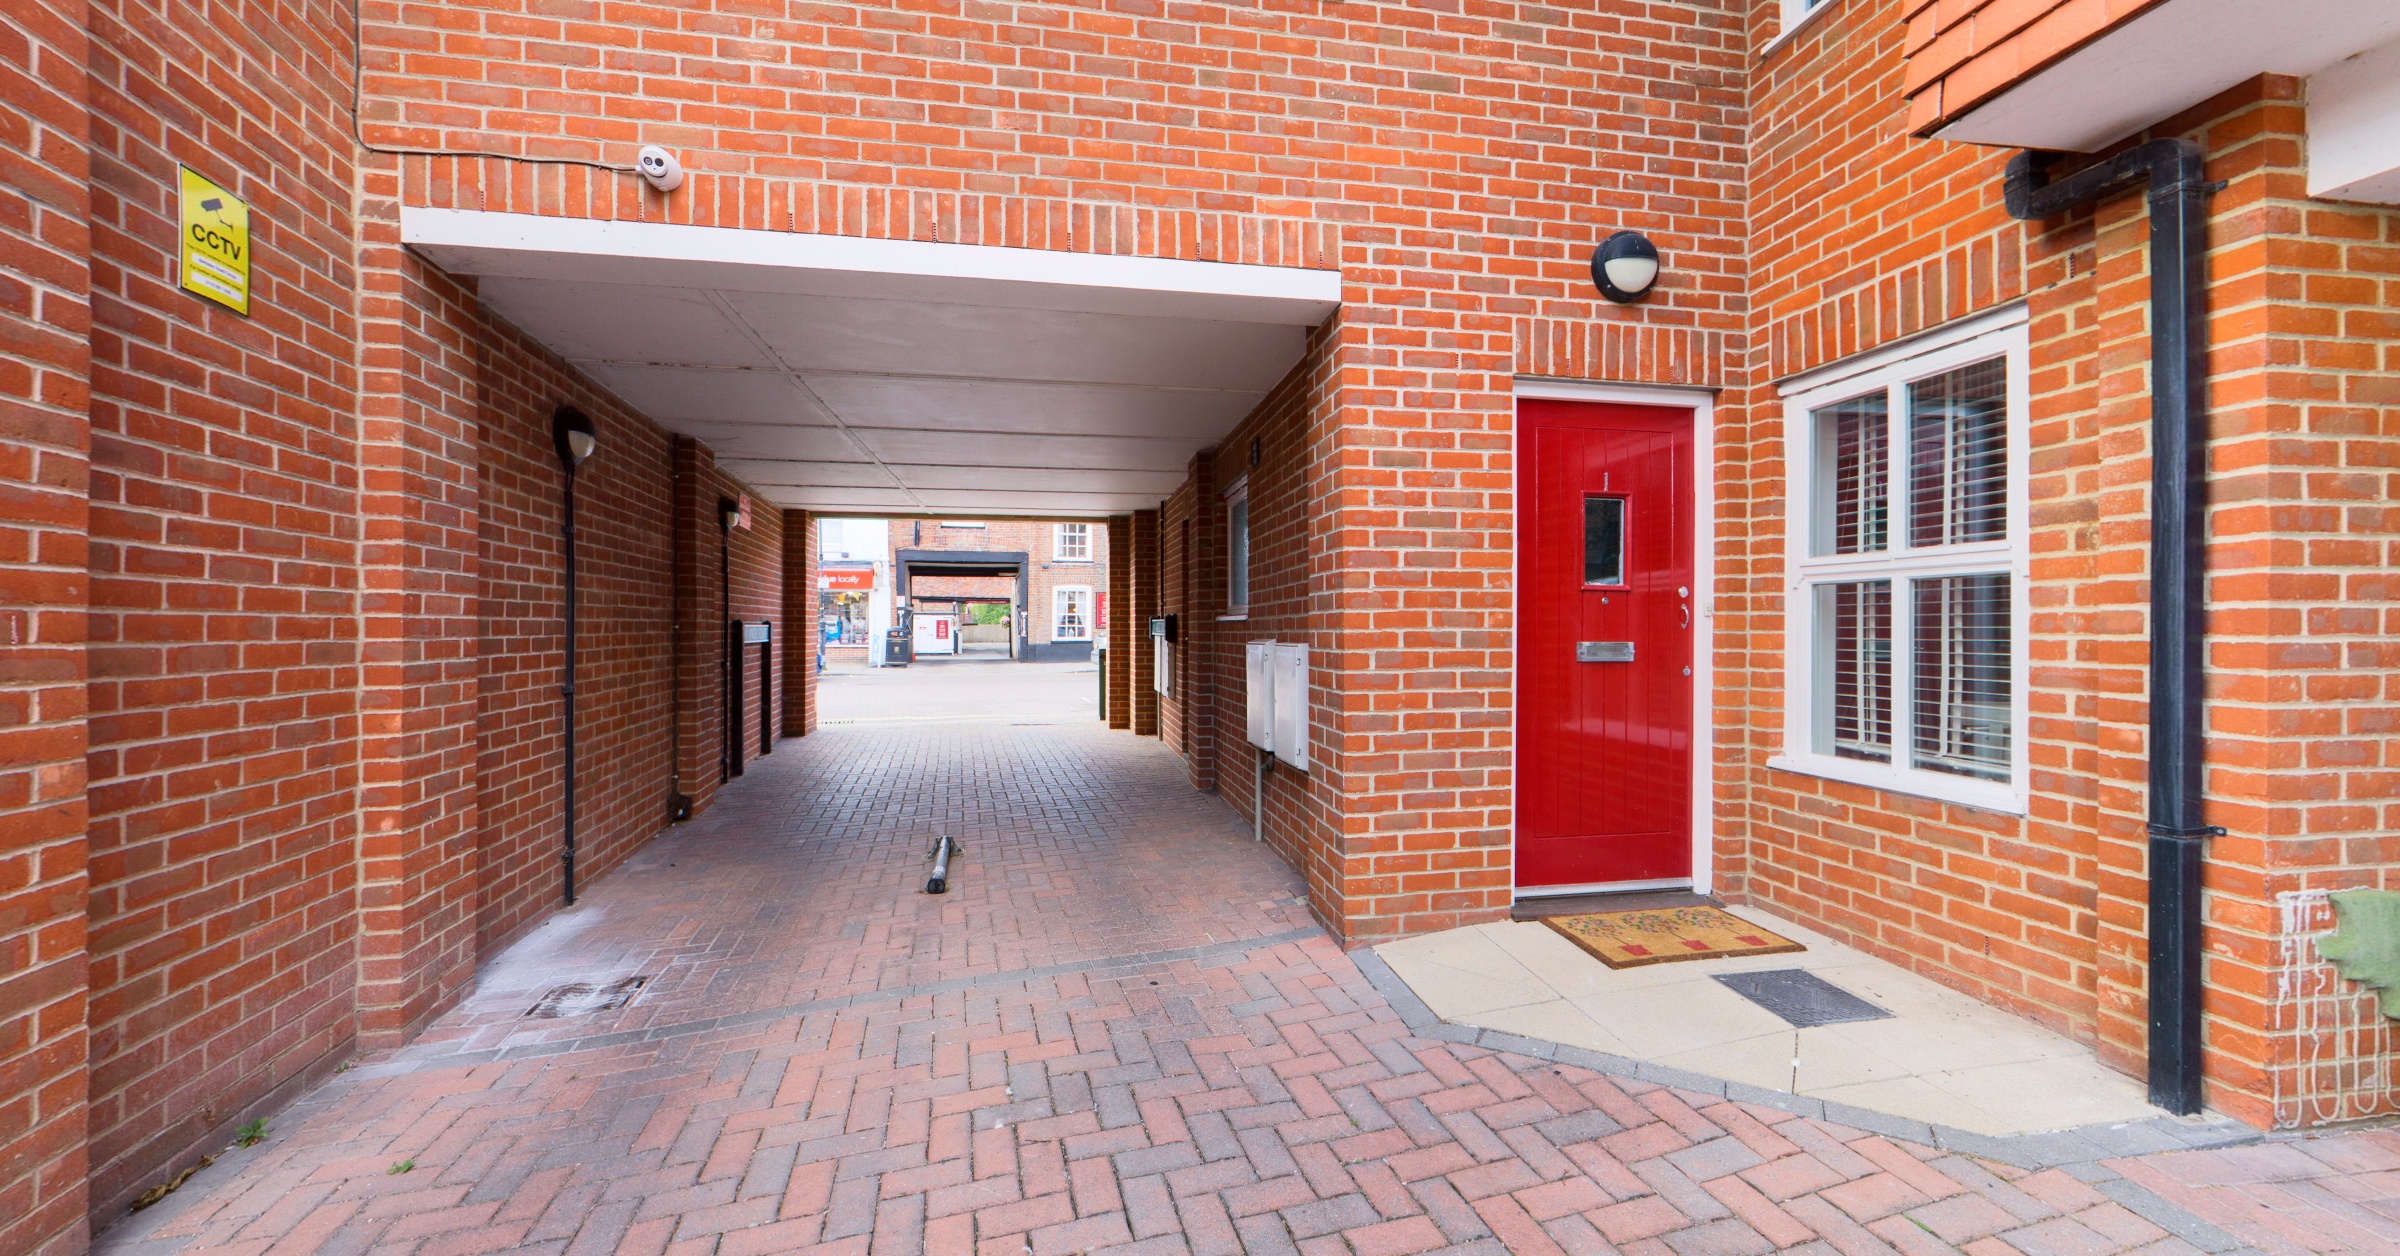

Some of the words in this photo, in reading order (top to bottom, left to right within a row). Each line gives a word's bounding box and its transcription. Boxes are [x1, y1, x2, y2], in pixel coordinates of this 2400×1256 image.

[191, 223, 241, 260] CCTV
[1603, 472, 1609, 491] 1
[837, 574, 860, 585] locally
